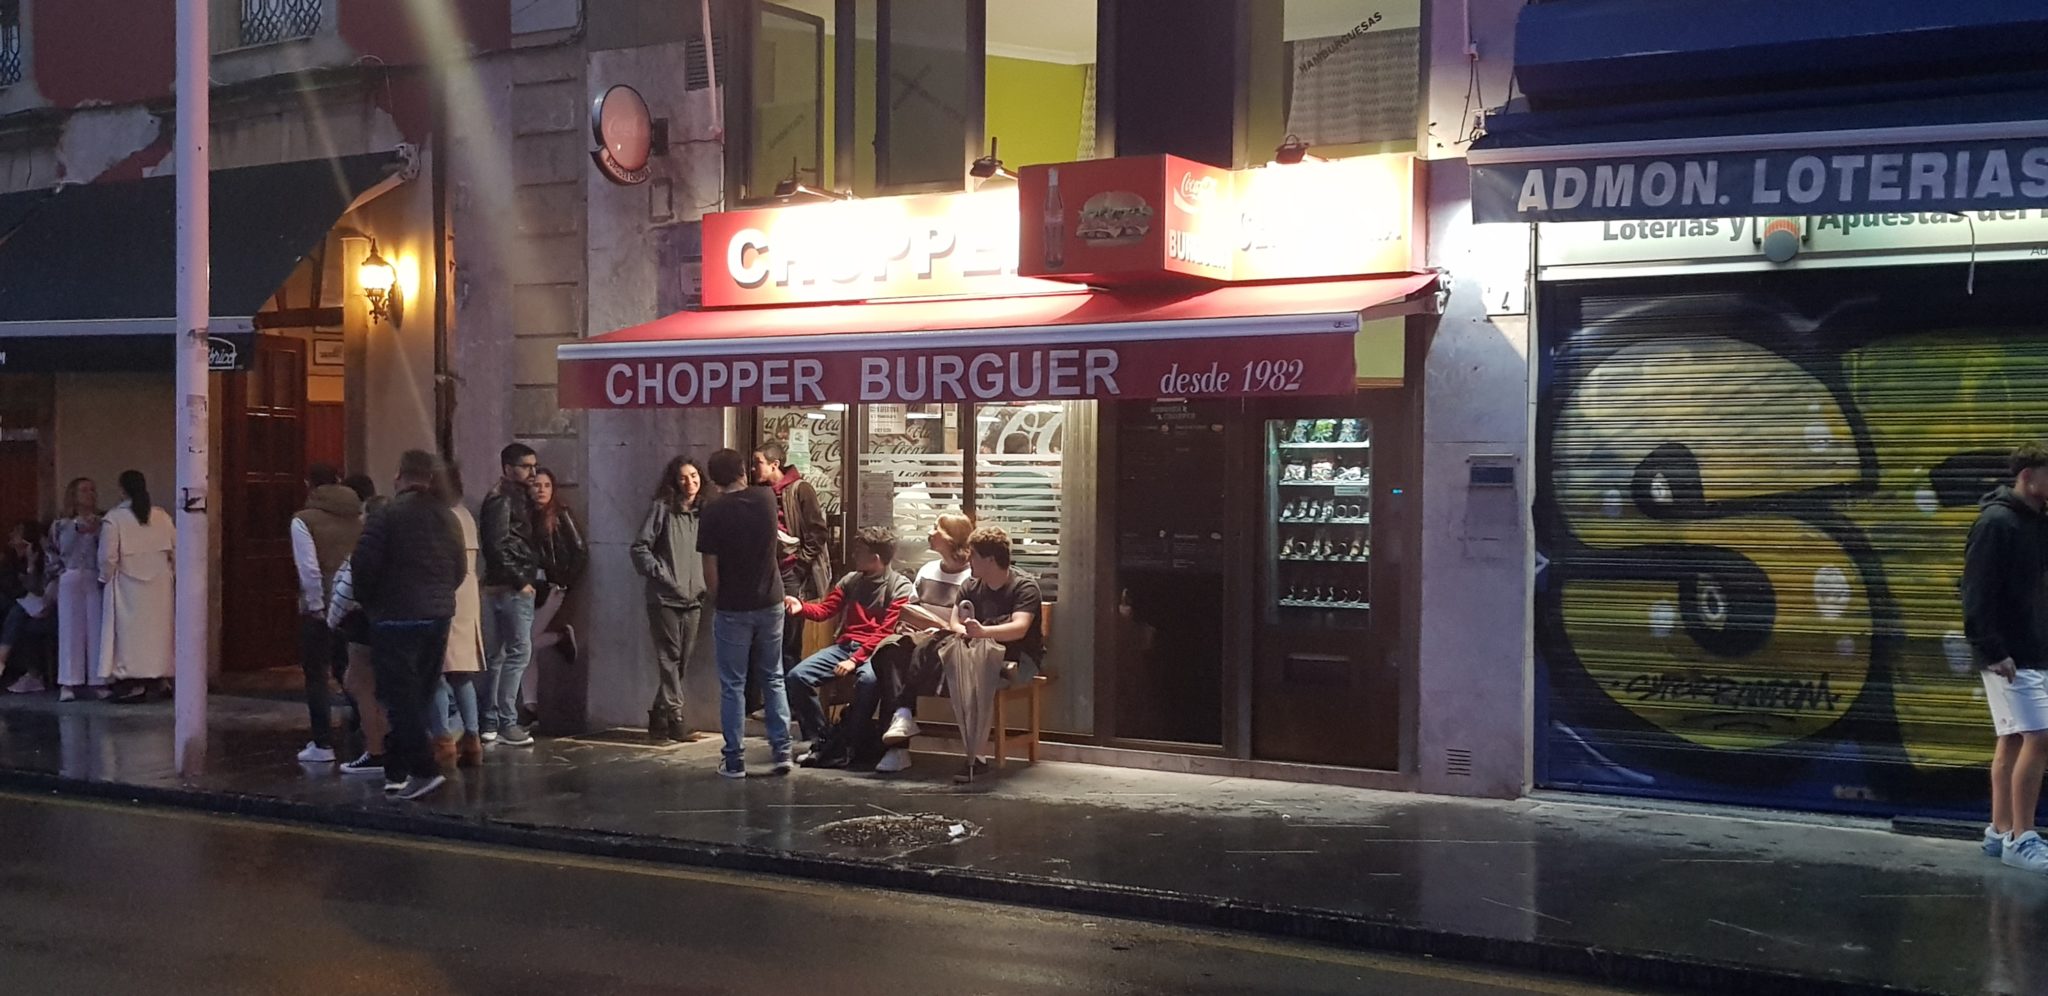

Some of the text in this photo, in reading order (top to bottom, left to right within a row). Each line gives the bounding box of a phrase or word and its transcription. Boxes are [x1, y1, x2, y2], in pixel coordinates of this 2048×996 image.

[1299, 11, 1383, 74] HAMBURGUESAS
[1517, 147, 2048, 212] ADMON. LOTERIAS
[1729, 217, 1746, 241] y
[1817, 212, 1965, 235] Apuestas
[605, 349, 1304, 405] CHOPPER BURGUER desde 1982
